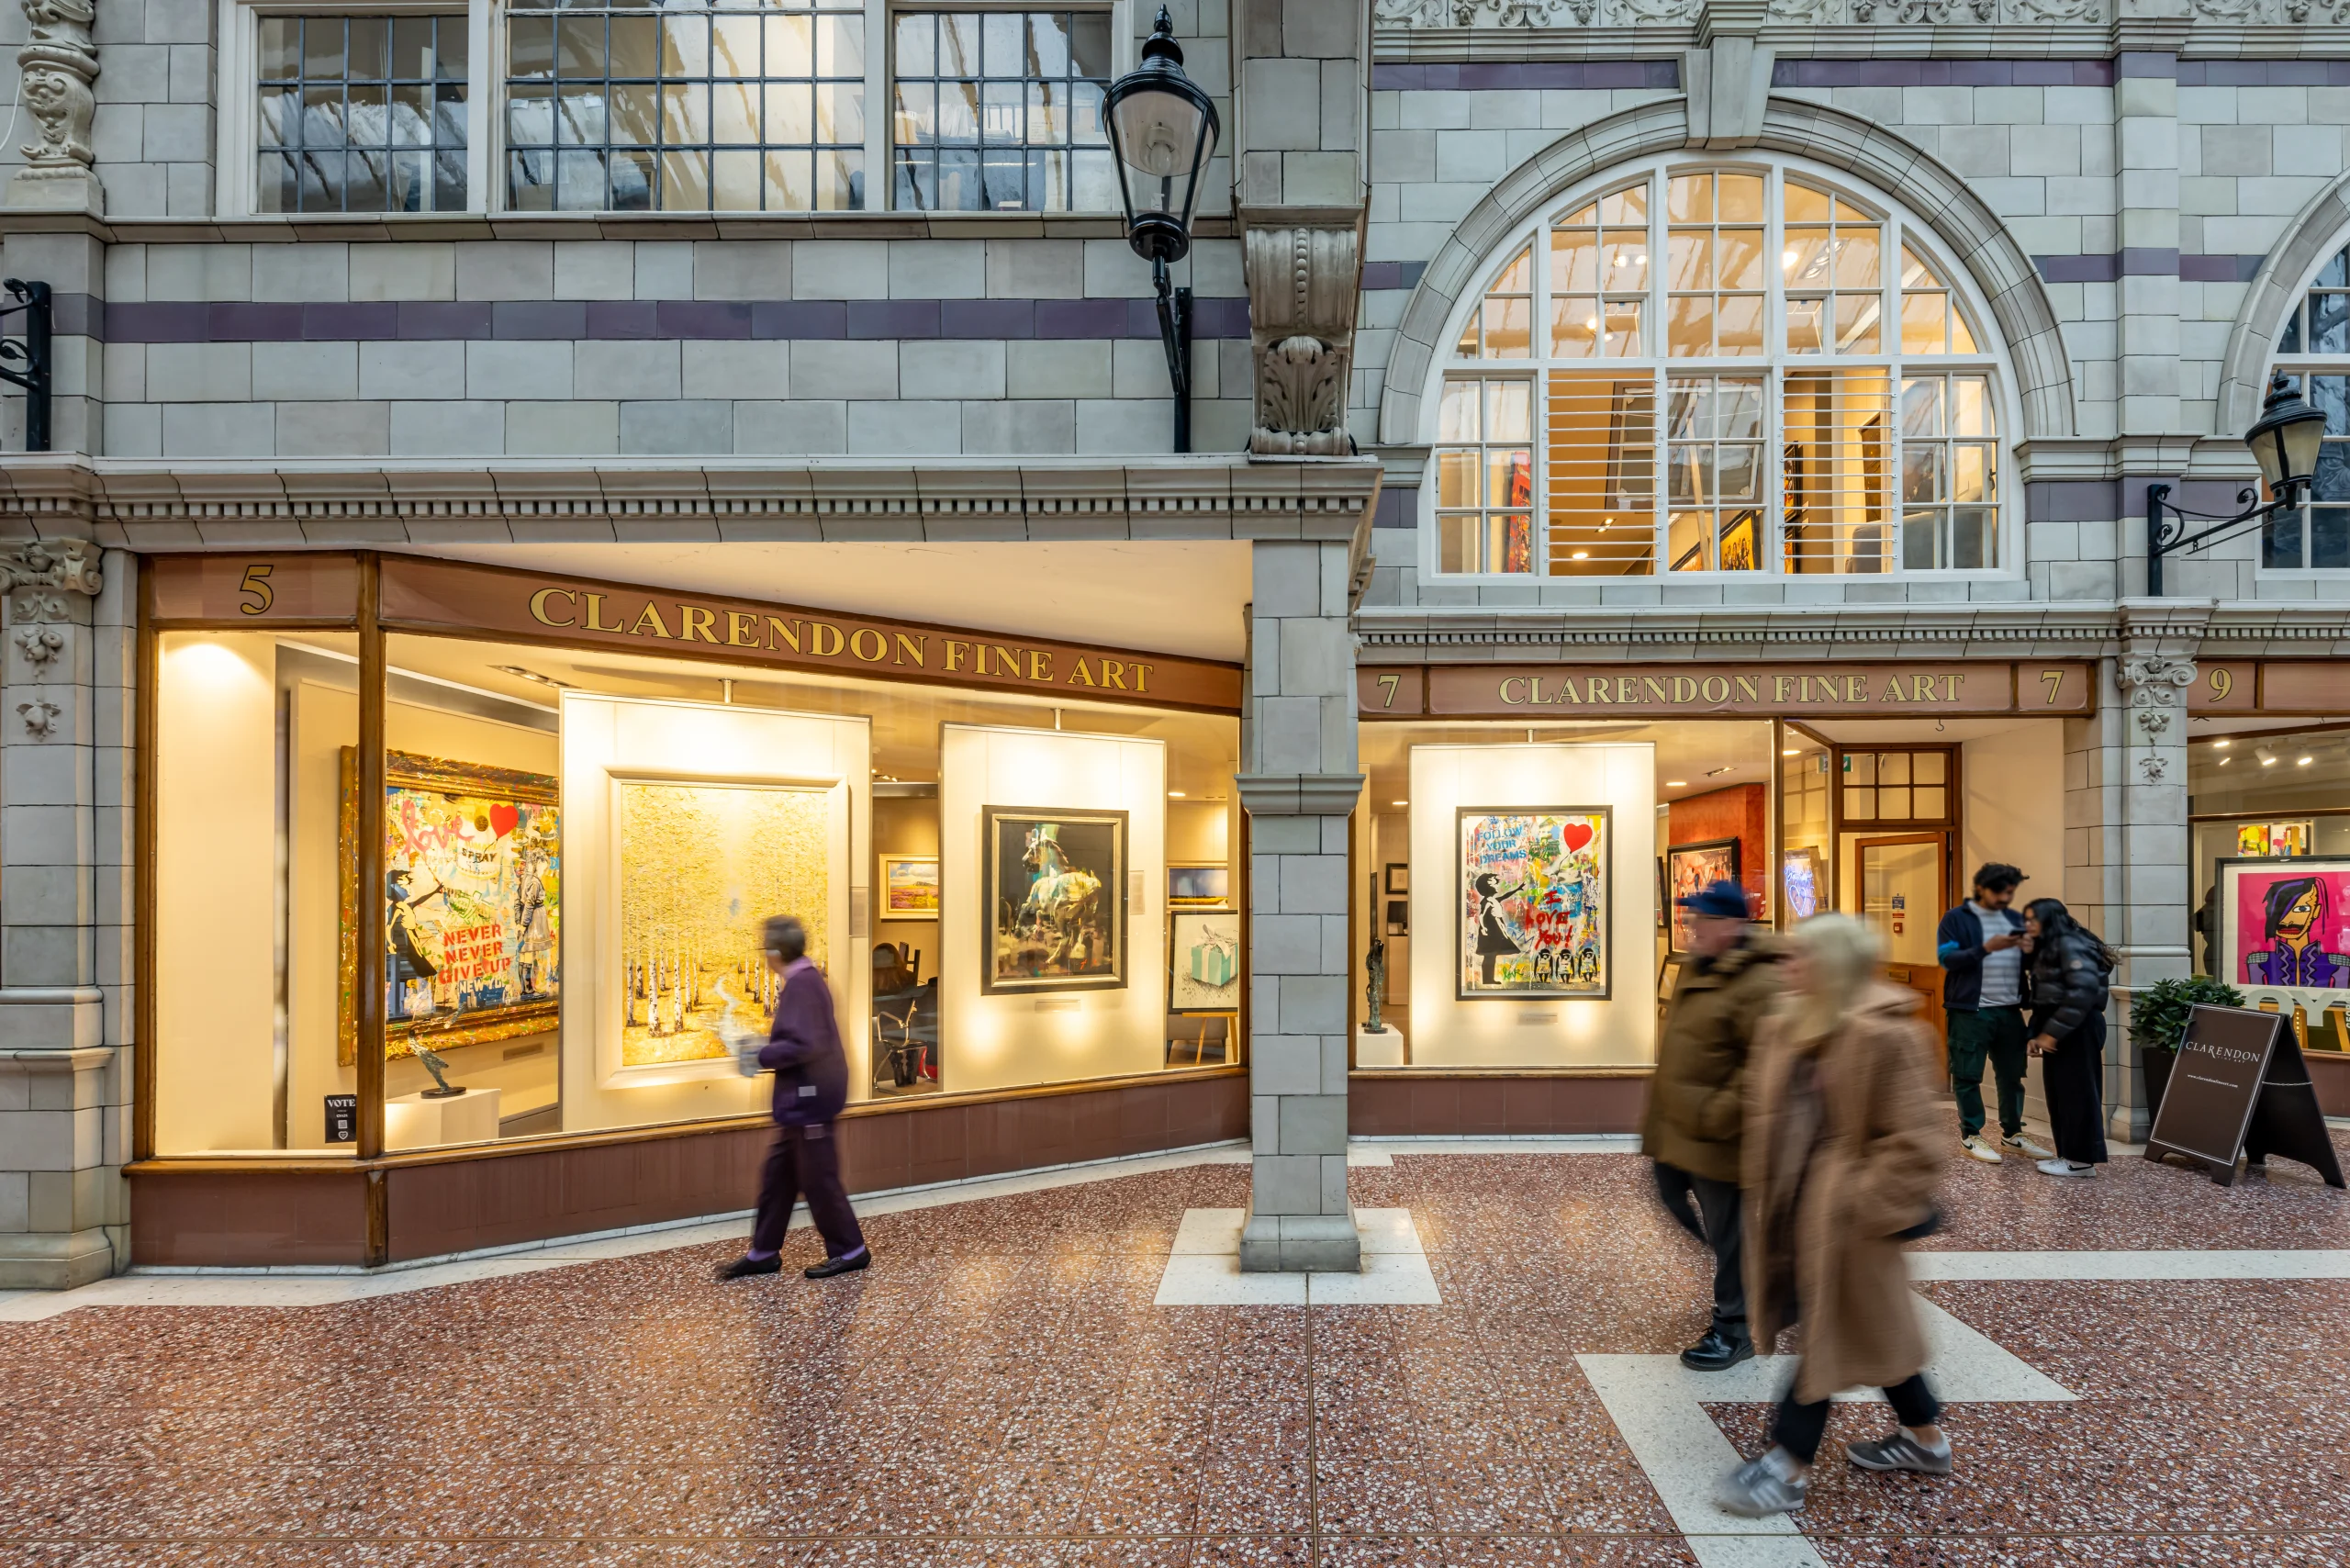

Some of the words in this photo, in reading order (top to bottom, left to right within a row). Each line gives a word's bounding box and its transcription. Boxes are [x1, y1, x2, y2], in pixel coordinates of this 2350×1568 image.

[240, 565, 274, 615] 5
[529, 587, 928, 668] CLARENDON
[941, 638, 1055, 682] FINE
[1067, 655, 1154, 693] ART
[1377, 674, 1401, 708] 7
[1499, 675, 1762, 705] CLARENDON
[1772, 674, 1868, 703] FINE
[1879, 674, 1965, 703] ART
[2040, 670, 2064, 705] 7
[2209, 668, 2232, 703] 9
[401, 799, 476, 856] love
[1476, 825, 1524, 841] FOLLOW
[462, 848, 498, 863] SPRAY
[1486, 839, 1516, 852] YOUR
[1480, 849, 1527, 865] DREAMS
[1544, 890, 1561, 904] I
[1525, 909, 1571, 926] LOVE
[443, 924, 501, 946] NEVER
[445, 941, 503, 964] NEVER
[438, 961, 484, 984] GIVE
[490, 958, 511, 974] UP
[459, 979, 484, 993] NEW
[2186, 1041, 2260, 1062] CLARENDON
[327, 1098, 356, 1107] VOTE
